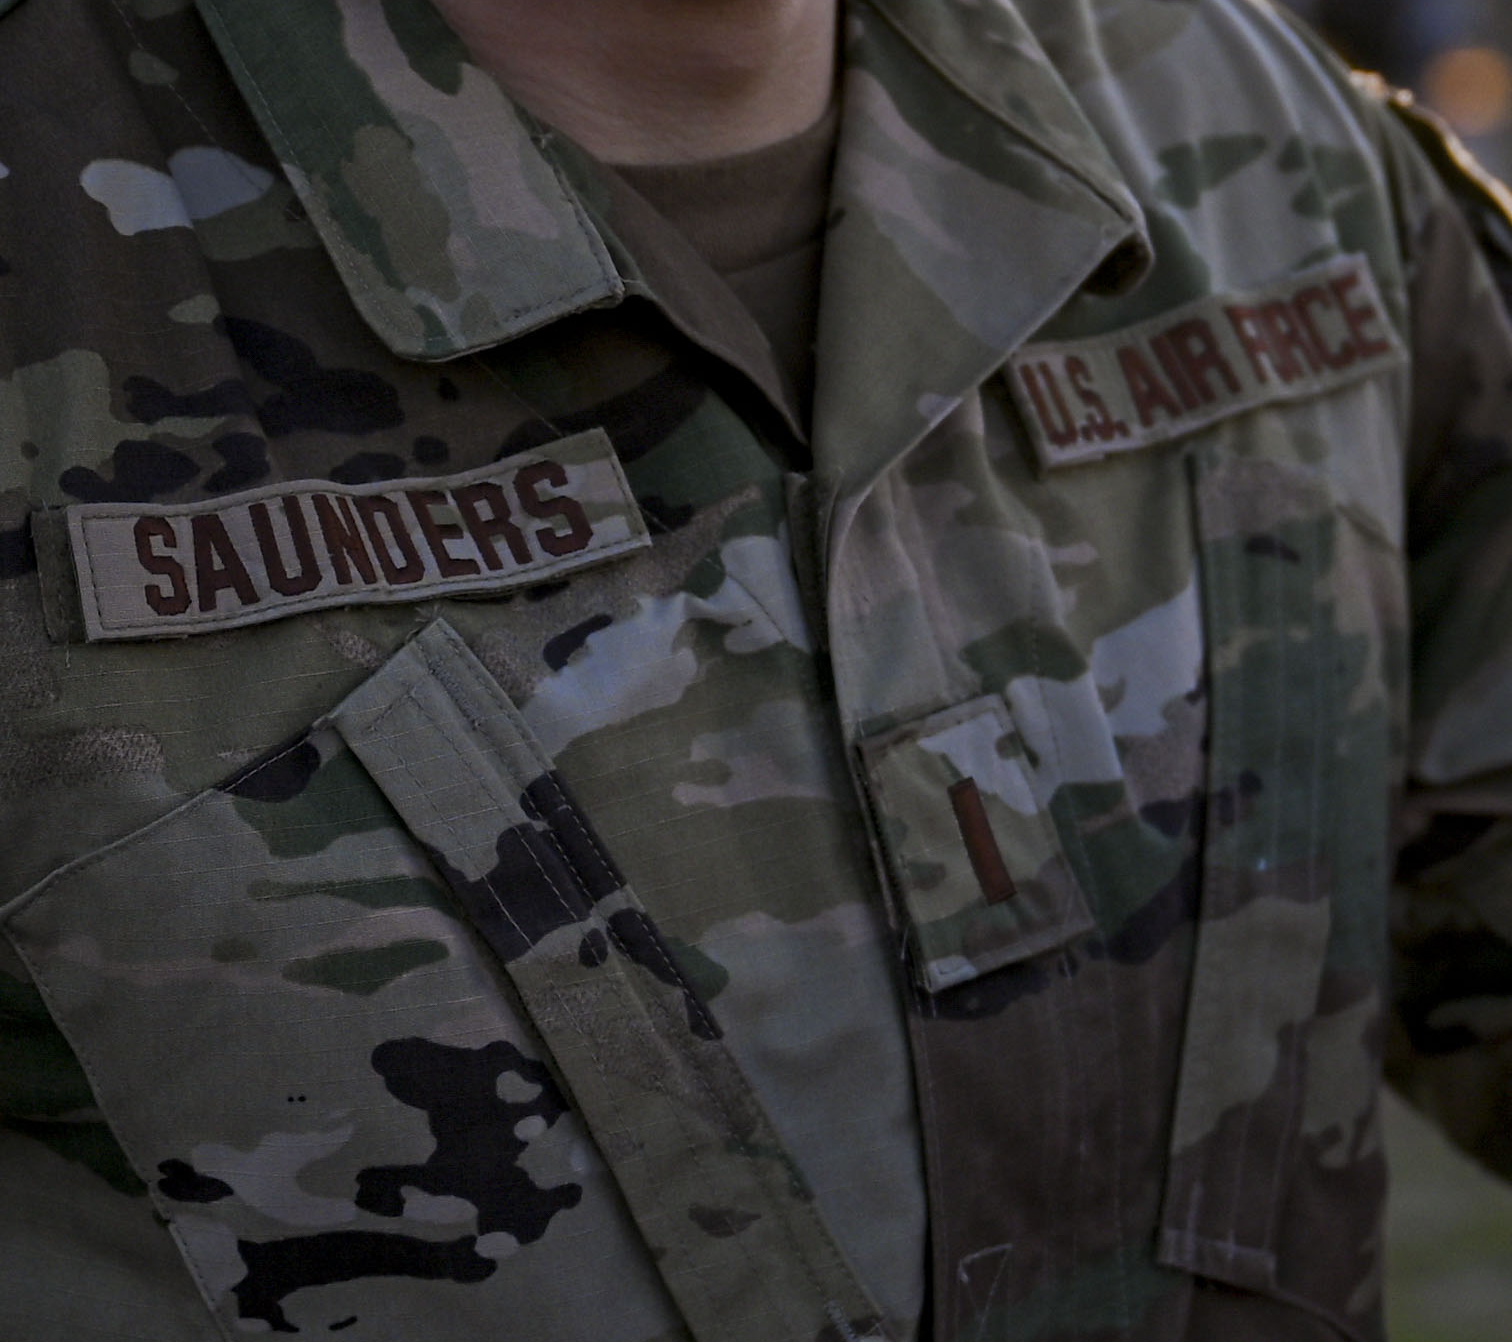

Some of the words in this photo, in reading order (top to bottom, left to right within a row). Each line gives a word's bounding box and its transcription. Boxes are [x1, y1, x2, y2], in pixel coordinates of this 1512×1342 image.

[1019, 355, 1130, 449] U.S.
[1117, 317, 1243, 428] AIR
[132, 460, 595, 617] SAUNDERS
